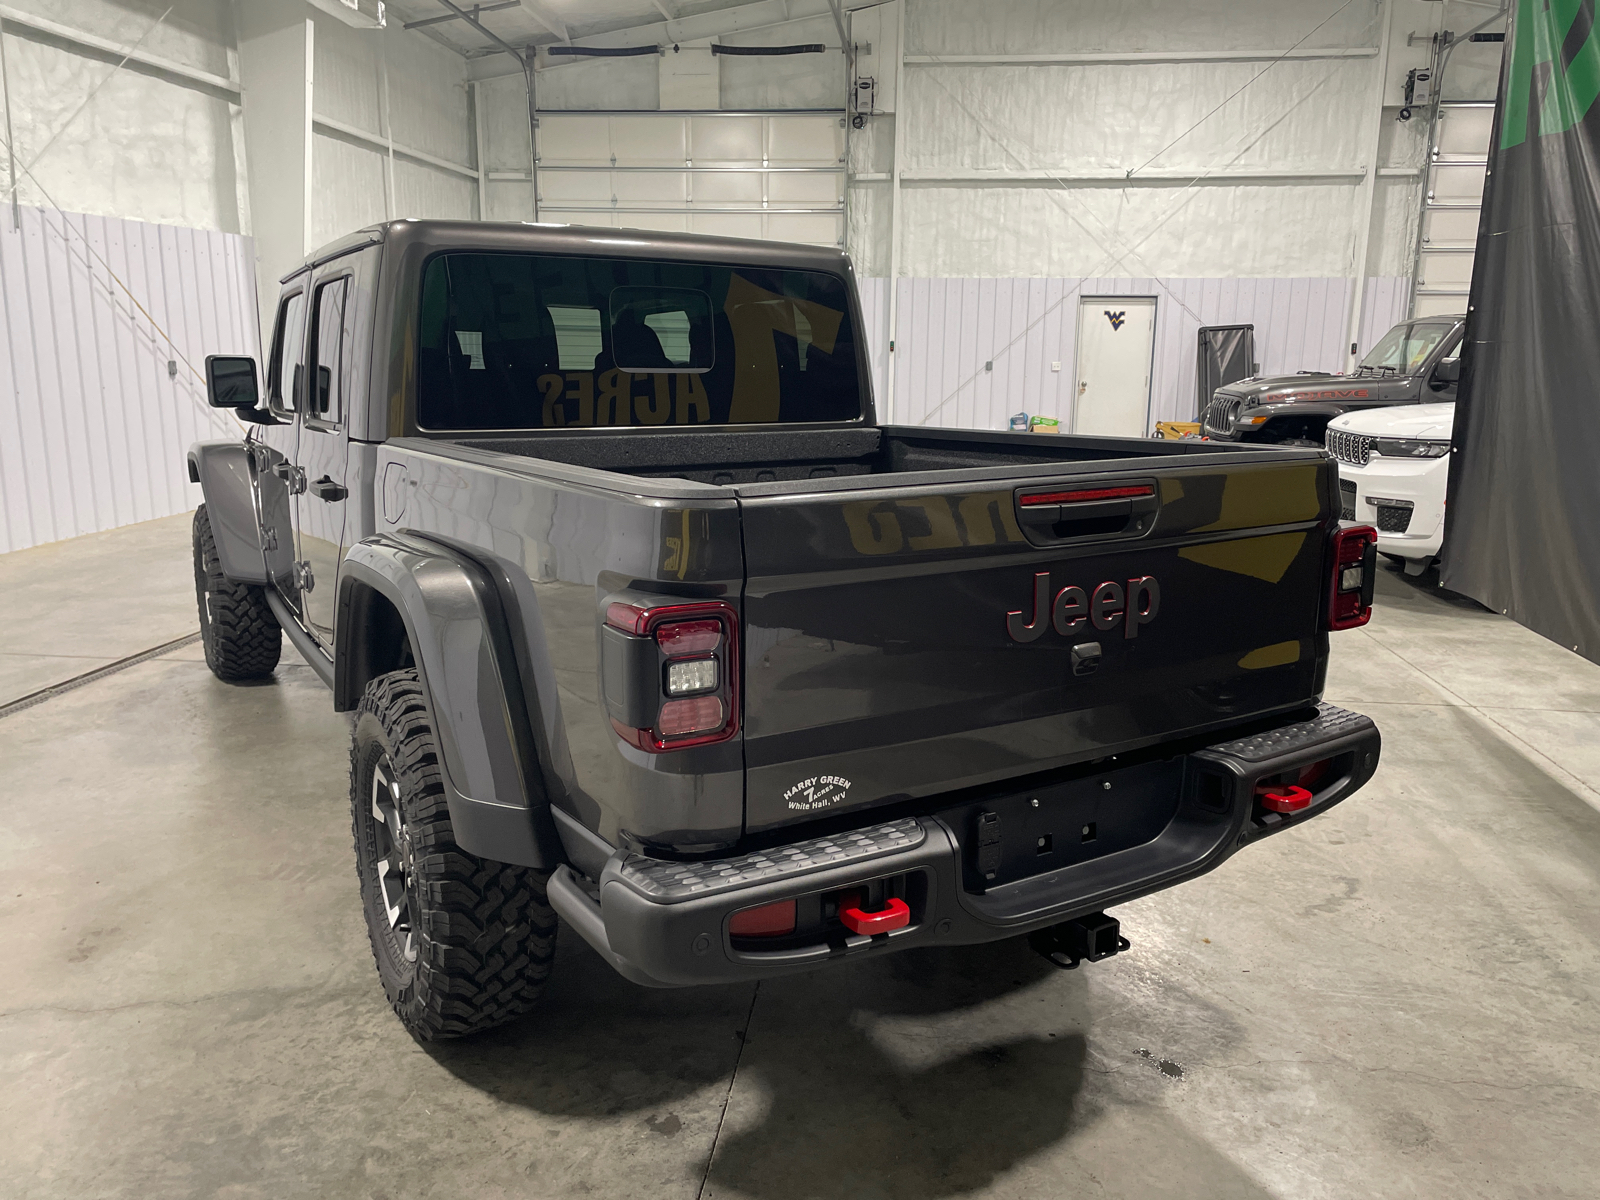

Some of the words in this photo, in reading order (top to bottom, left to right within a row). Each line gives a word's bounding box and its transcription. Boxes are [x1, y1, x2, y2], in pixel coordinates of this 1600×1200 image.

[1267, 389, 1369, 402] MOJAVE
[1006, 571, 1161, 643] Jeep
[783, 776, 818, 800] HARRY
[820, 775, 852, 790] GREEN
[803, 786, 815, 803] 7
[813, 784, 834, 800] ACRES
[788, 801, 810, 810] White
[812, 799, 831, 810] Hall,
[832, 791, 846, 803] WV
